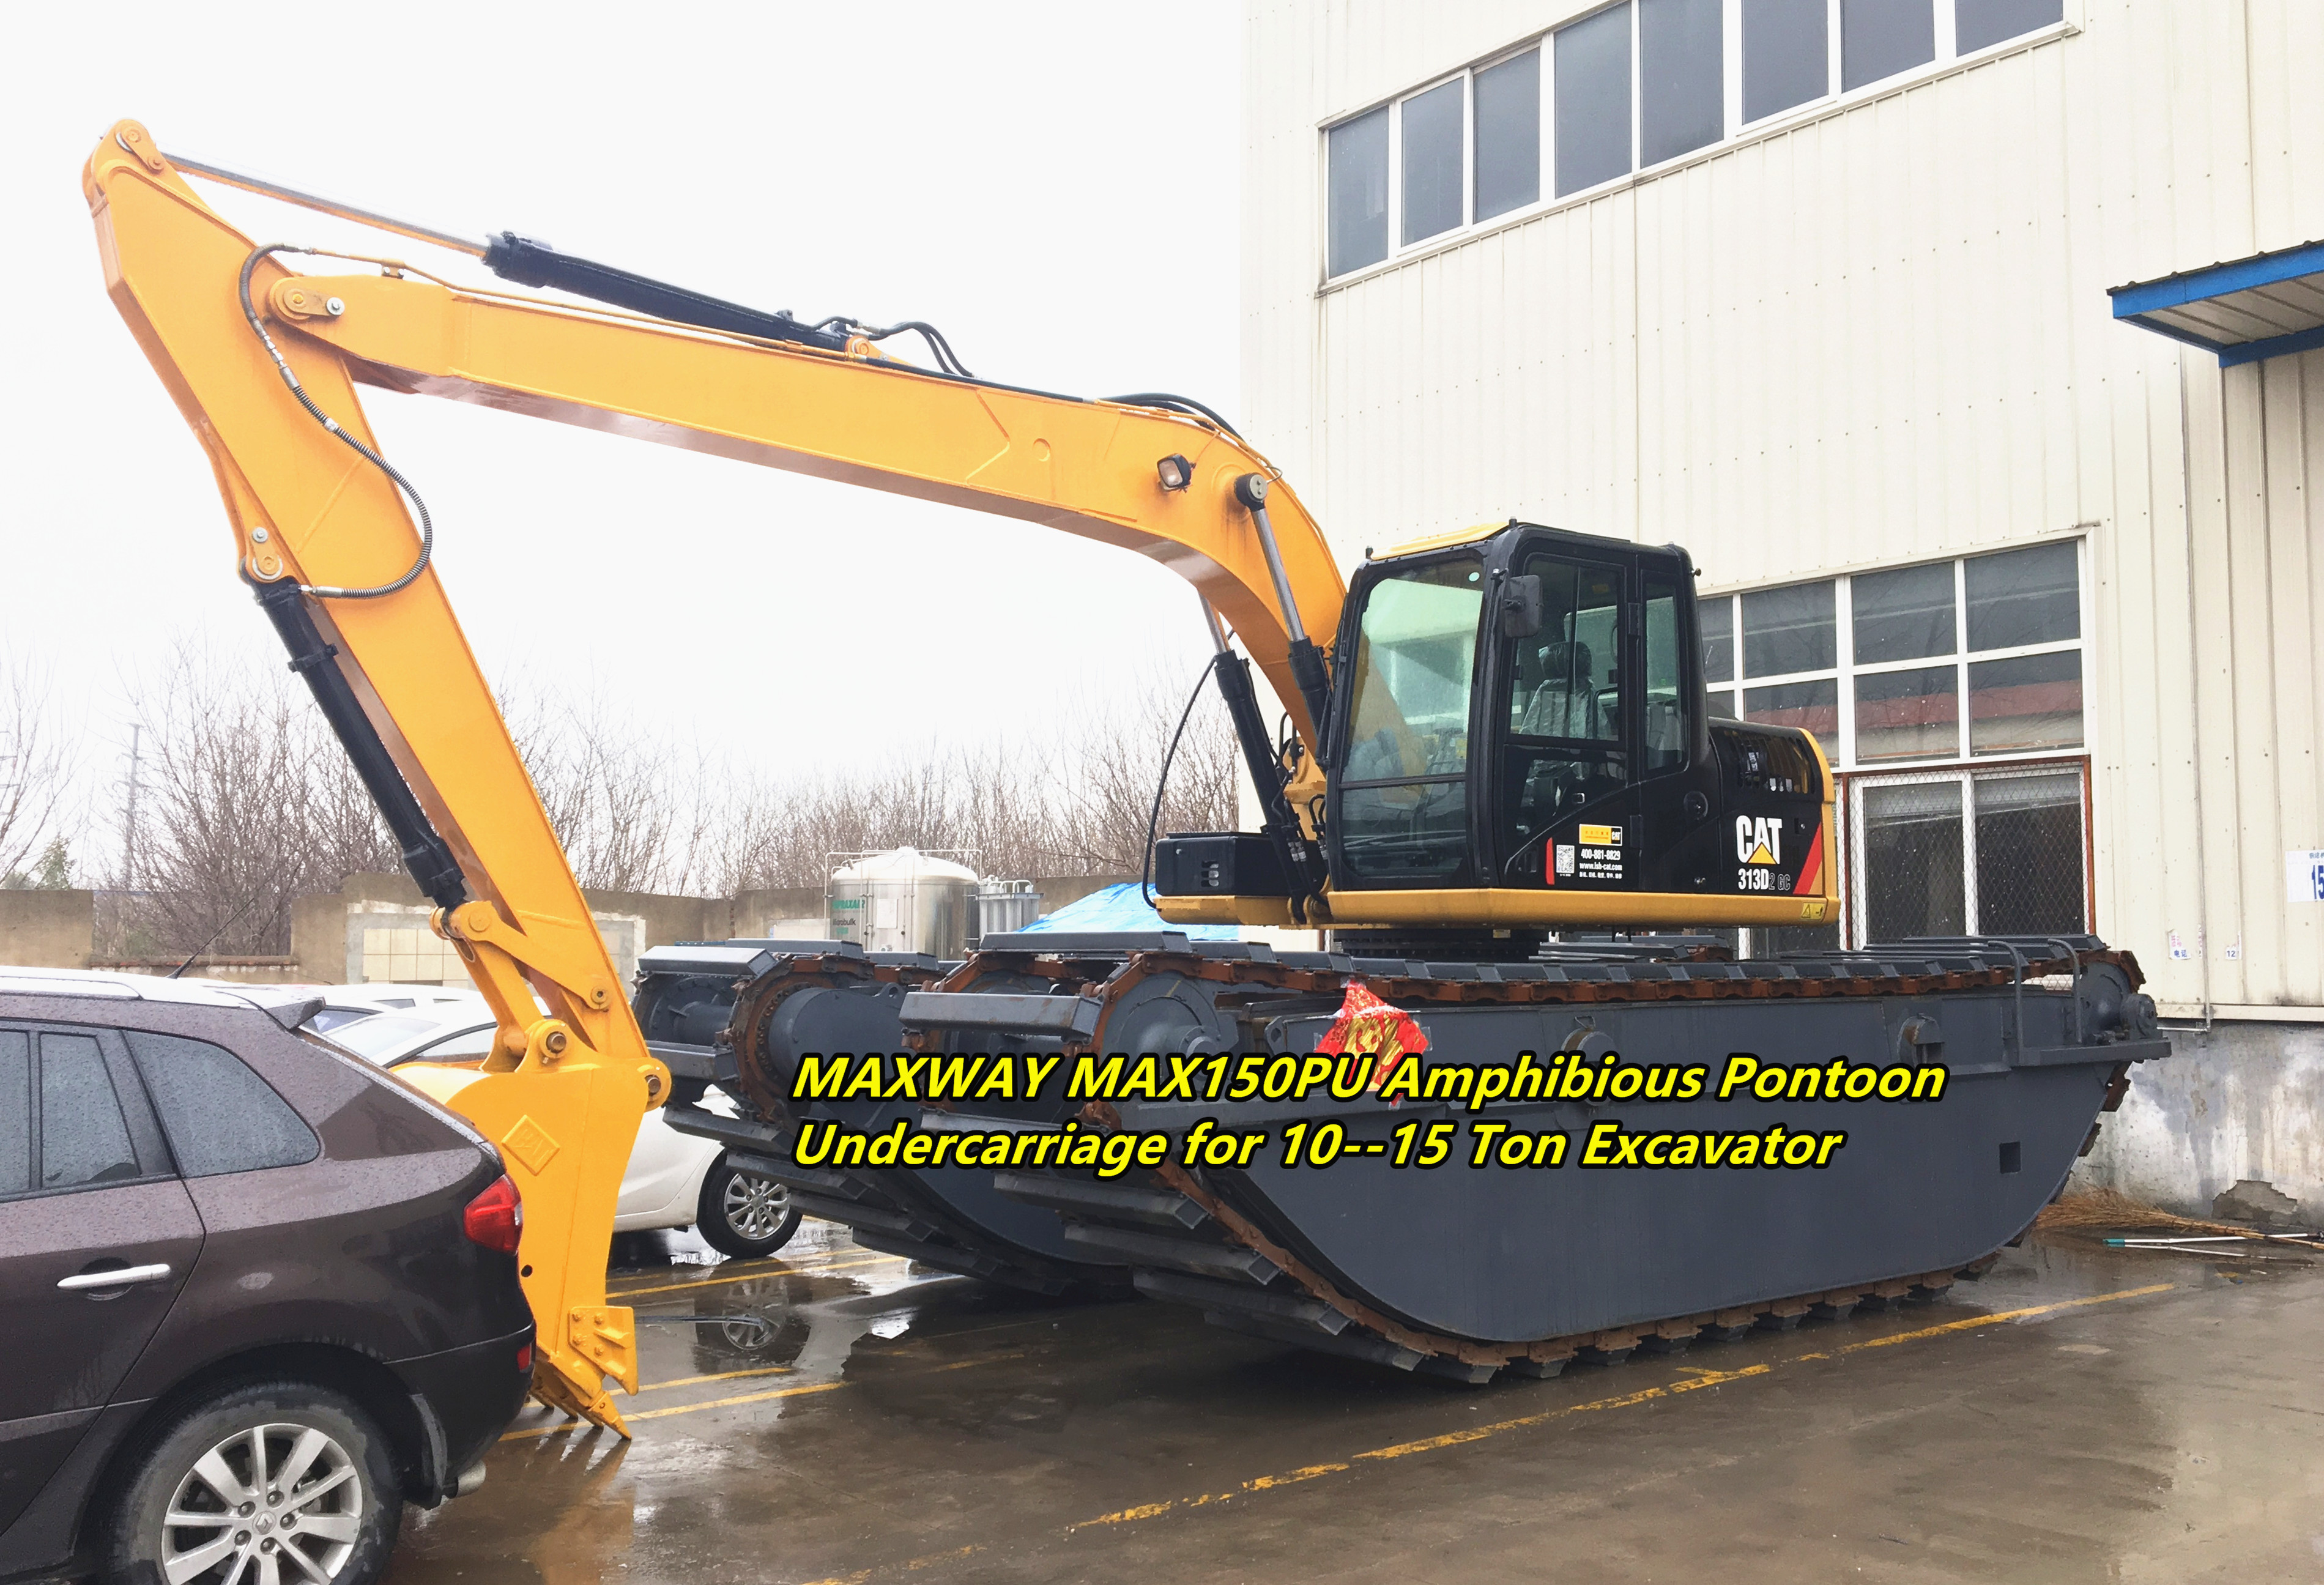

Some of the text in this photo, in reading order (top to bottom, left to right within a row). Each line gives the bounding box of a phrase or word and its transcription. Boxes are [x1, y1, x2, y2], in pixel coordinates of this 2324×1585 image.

[1736, 815, 1783, 865] CAT
[1738, 868, 1791, 891] 313D2 GC
